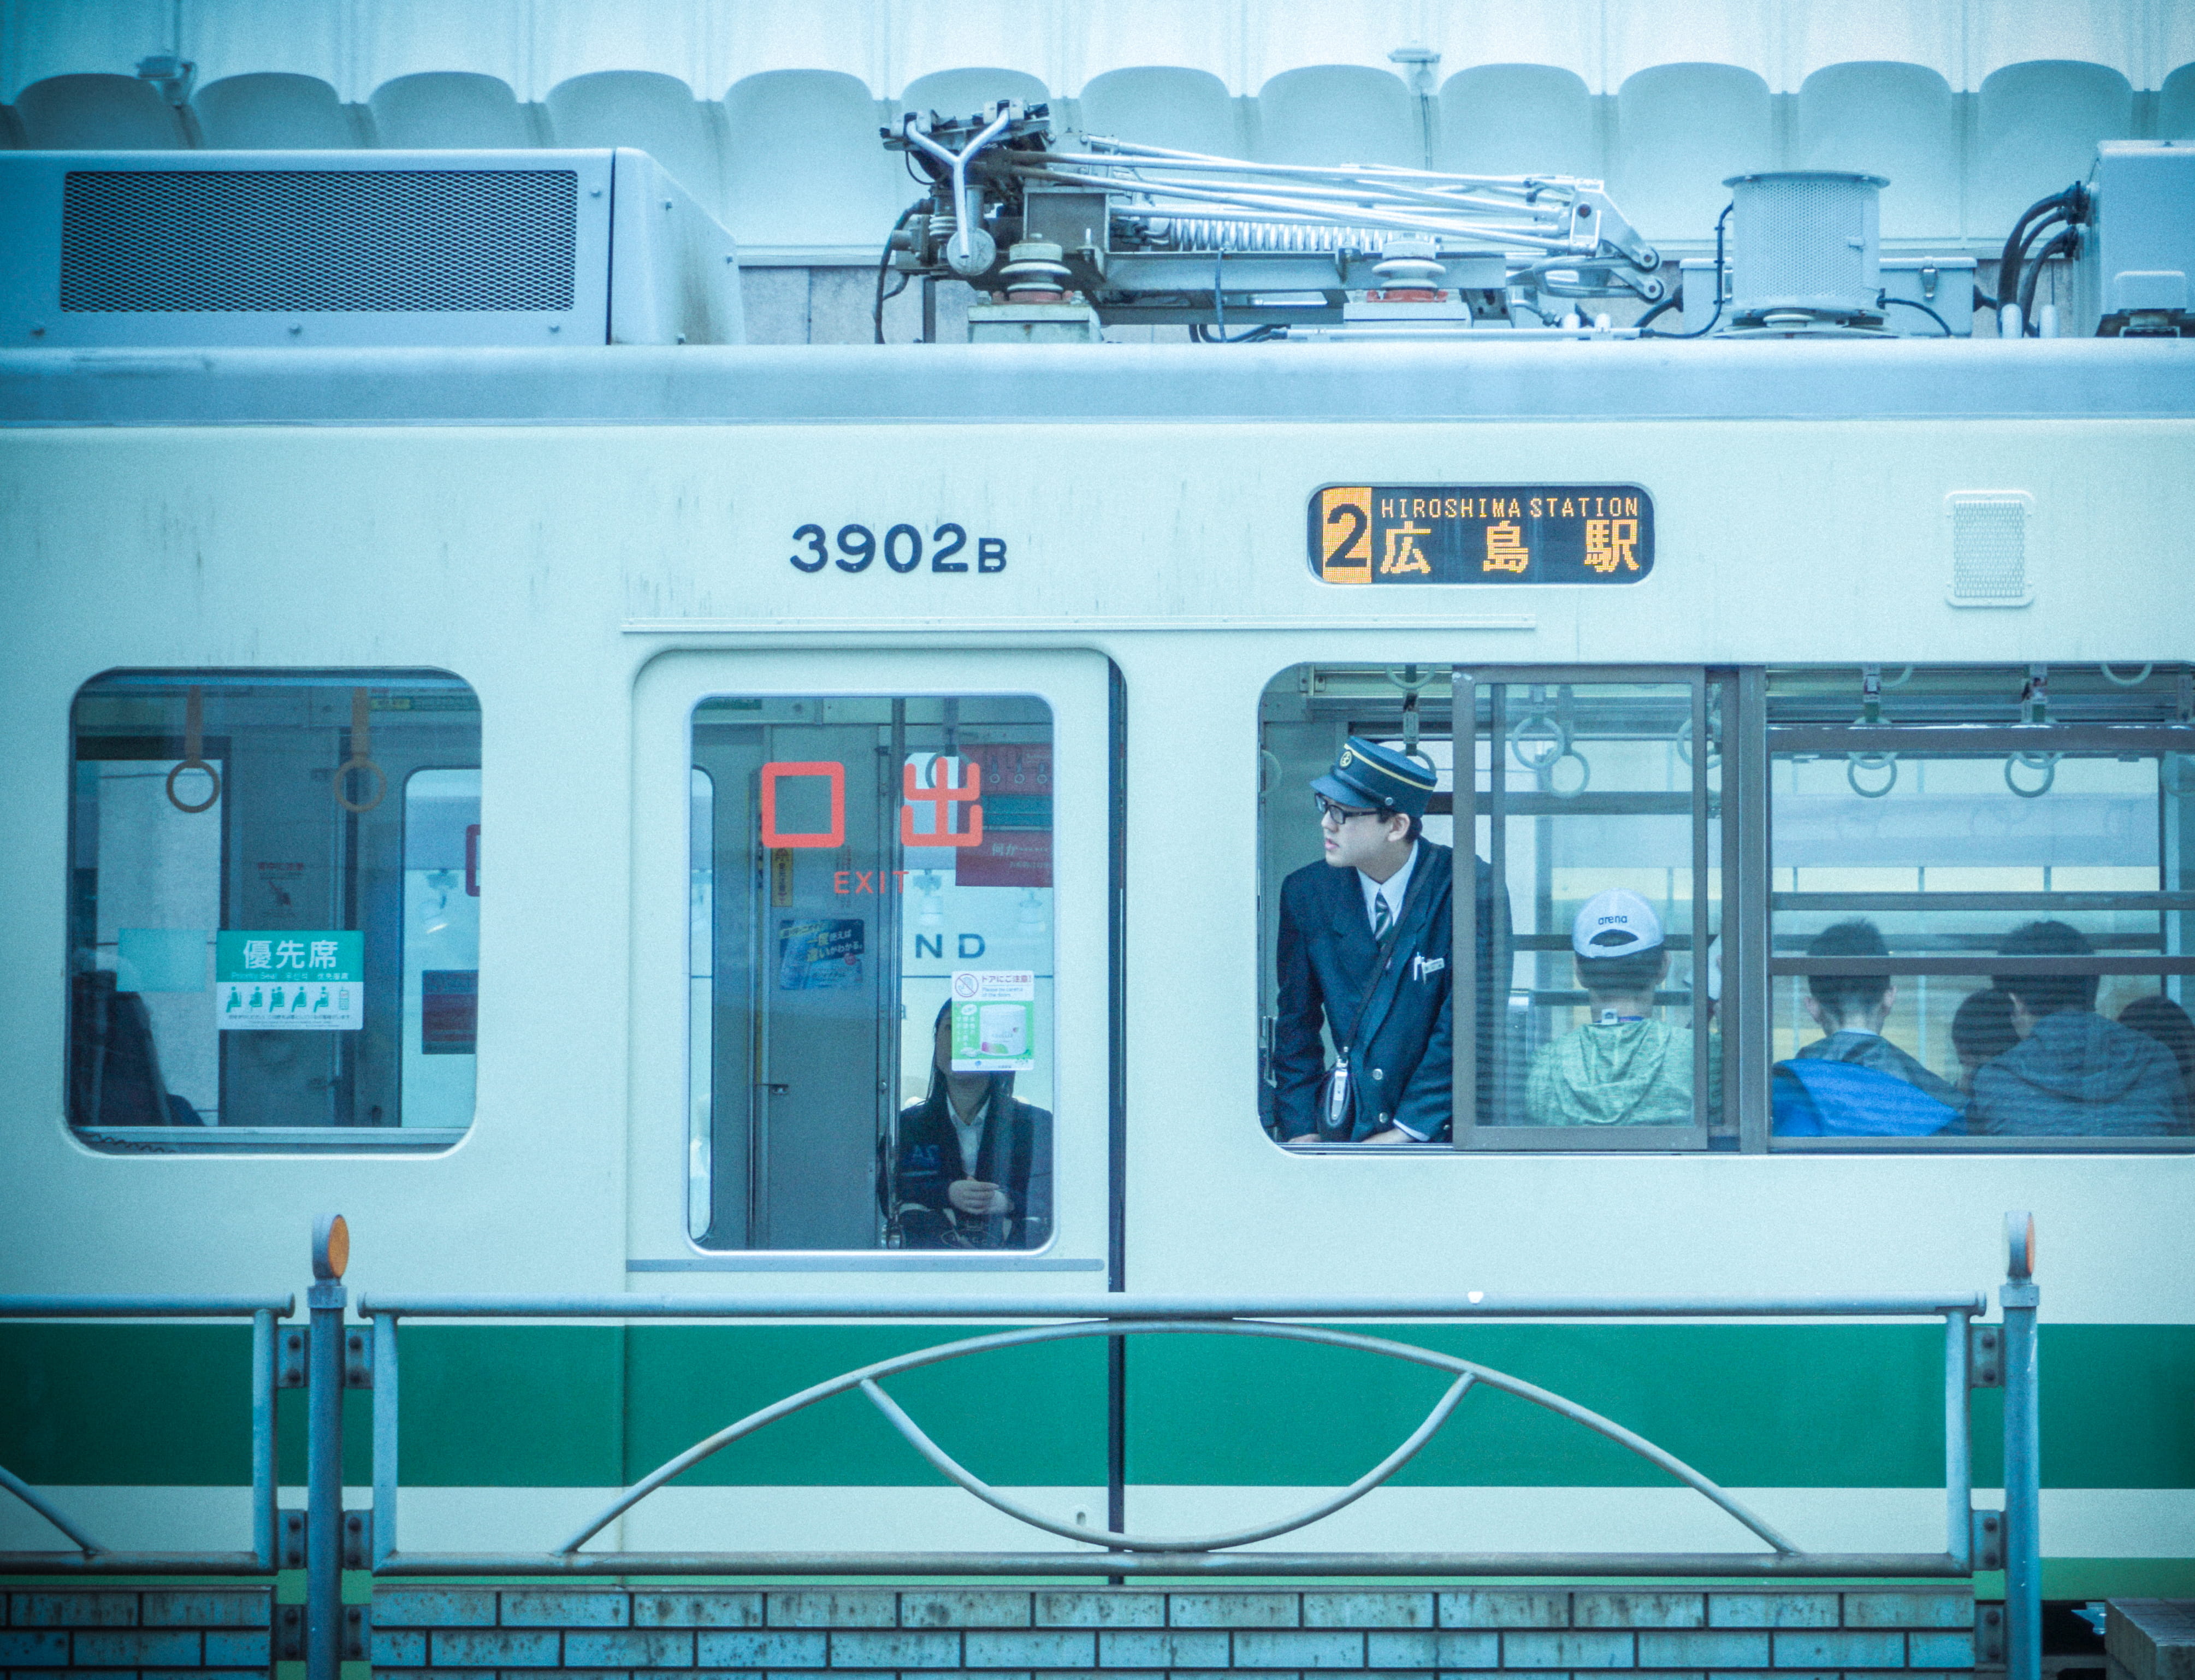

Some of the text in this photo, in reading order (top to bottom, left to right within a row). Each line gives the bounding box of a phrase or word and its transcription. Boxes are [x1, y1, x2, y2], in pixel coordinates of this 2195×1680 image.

[1381, 498, 1638, 518] HIROSHIMA STATION
[790, 523, 1007, 573] 3902B
[1326, 503, 1366, 567] 2
[833, 871, 909, 895] EXIT
[1598, 915, 1628, 925] arena
[243, 939, 339, 969] 優先席
